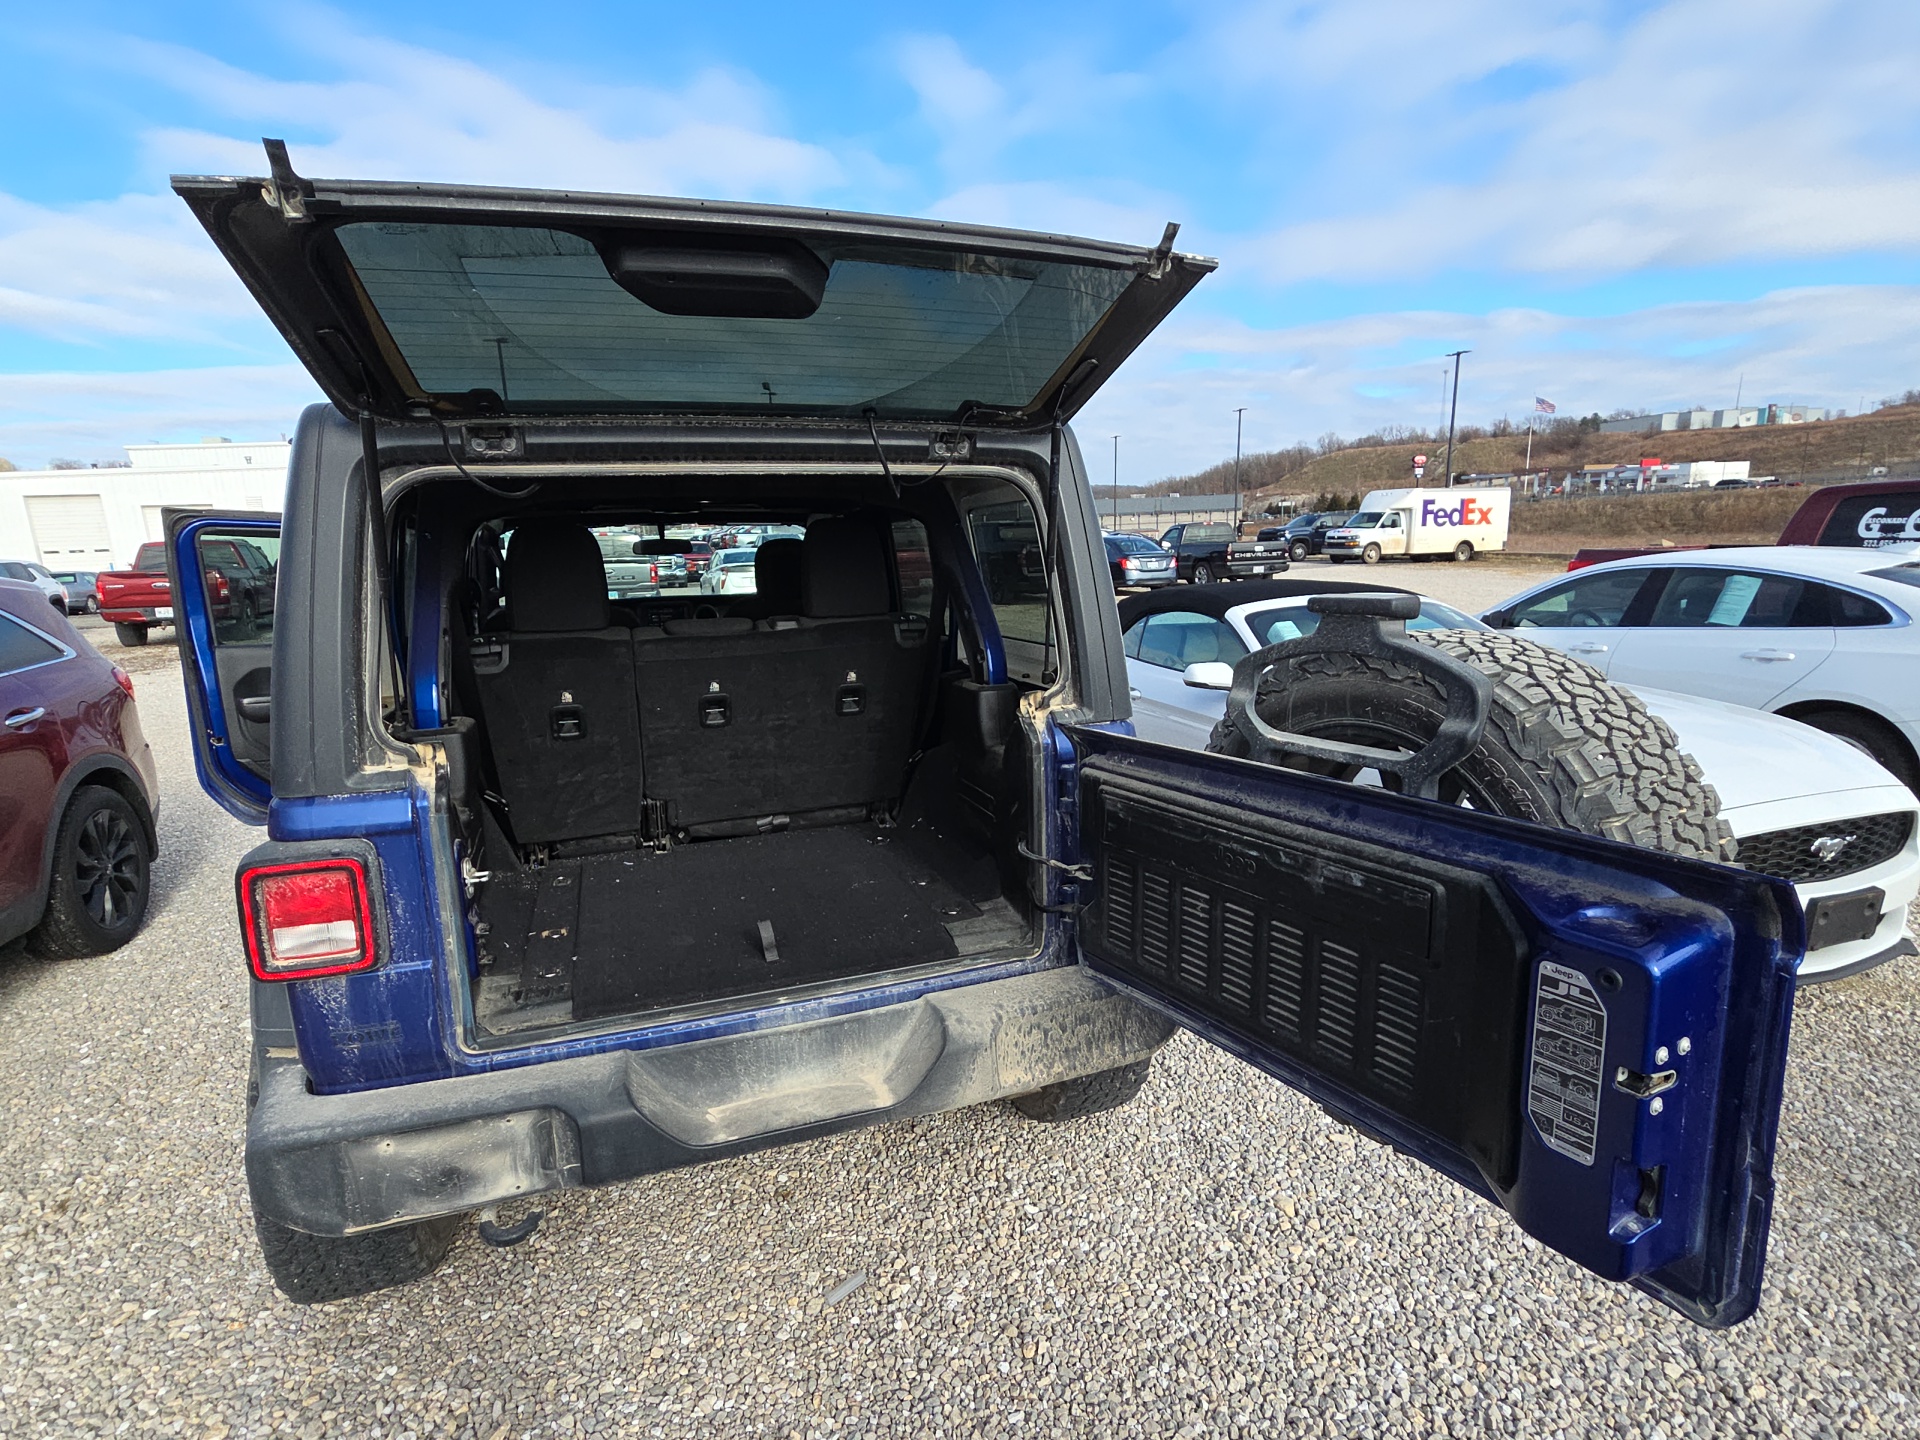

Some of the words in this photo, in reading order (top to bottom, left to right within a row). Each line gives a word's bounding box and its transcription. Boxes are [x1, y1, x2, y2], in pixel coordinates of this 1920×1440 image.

[1421, 498, 1493, 527] FedEx
[1234, 551, 1282, 559] CHEVROLET
[1551, 966, 1574, 980] Jeep
